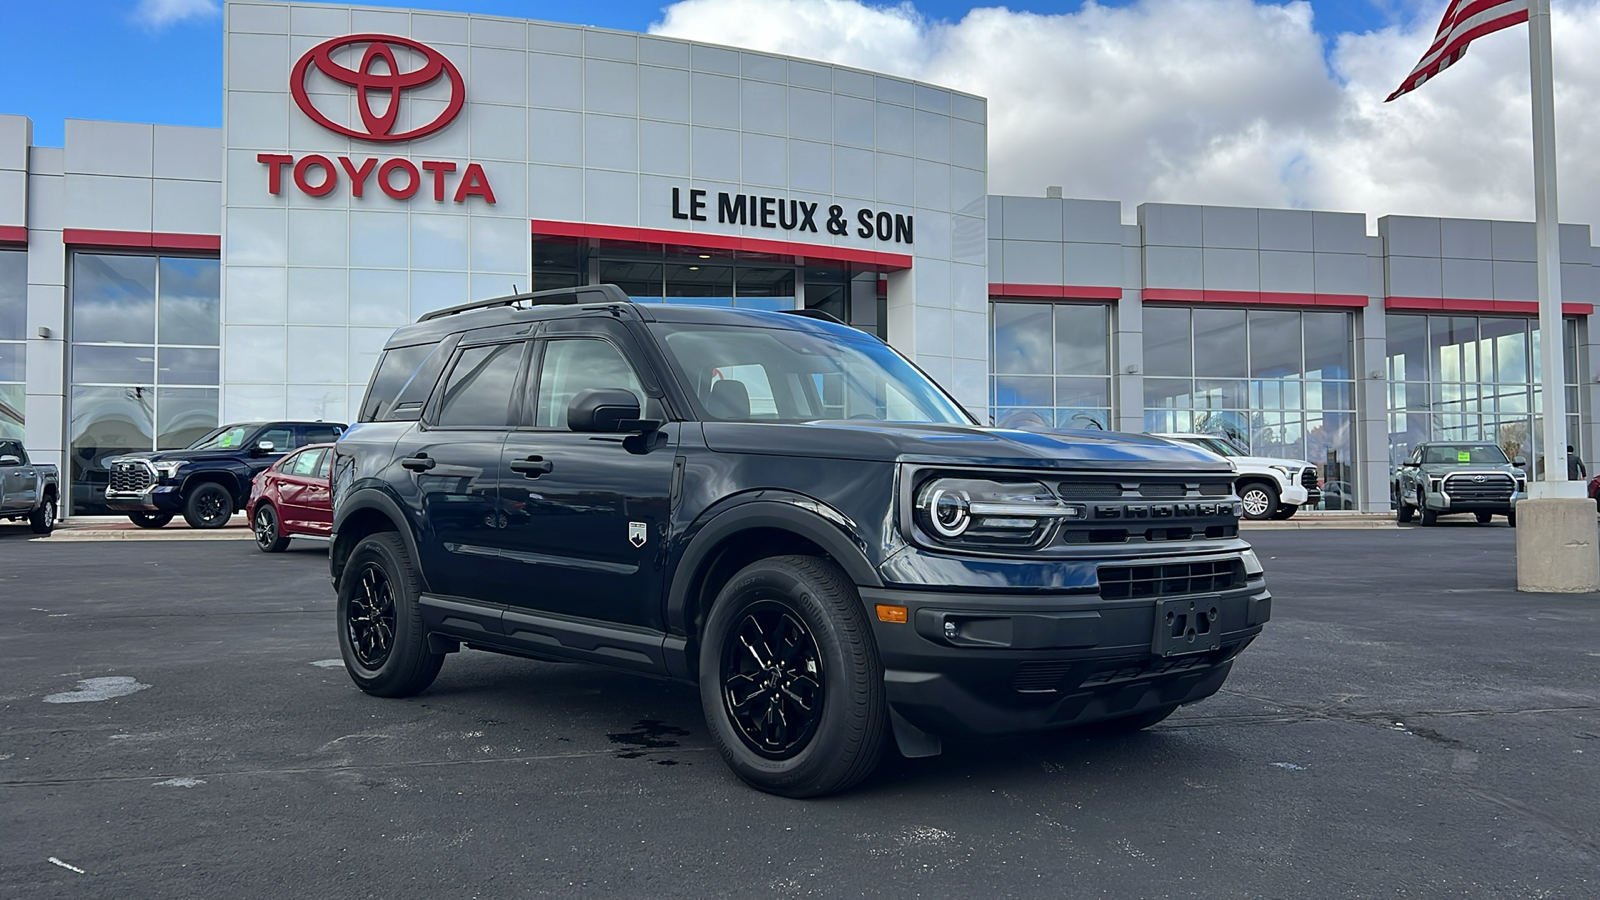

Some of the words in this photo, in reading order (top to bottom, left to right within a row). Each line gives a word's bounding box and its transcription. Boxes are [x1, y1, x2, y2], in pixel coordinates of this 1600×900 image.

[257, 153, 496, 204] TOYOTA
[672, 187, 707, 222] LE
[718, 192, 818, 233] MIEUX
[826, 204, 849, 237] &
[857, 208, 914, 245] SON
[1094, 503, 1232, 520] BRONCO
